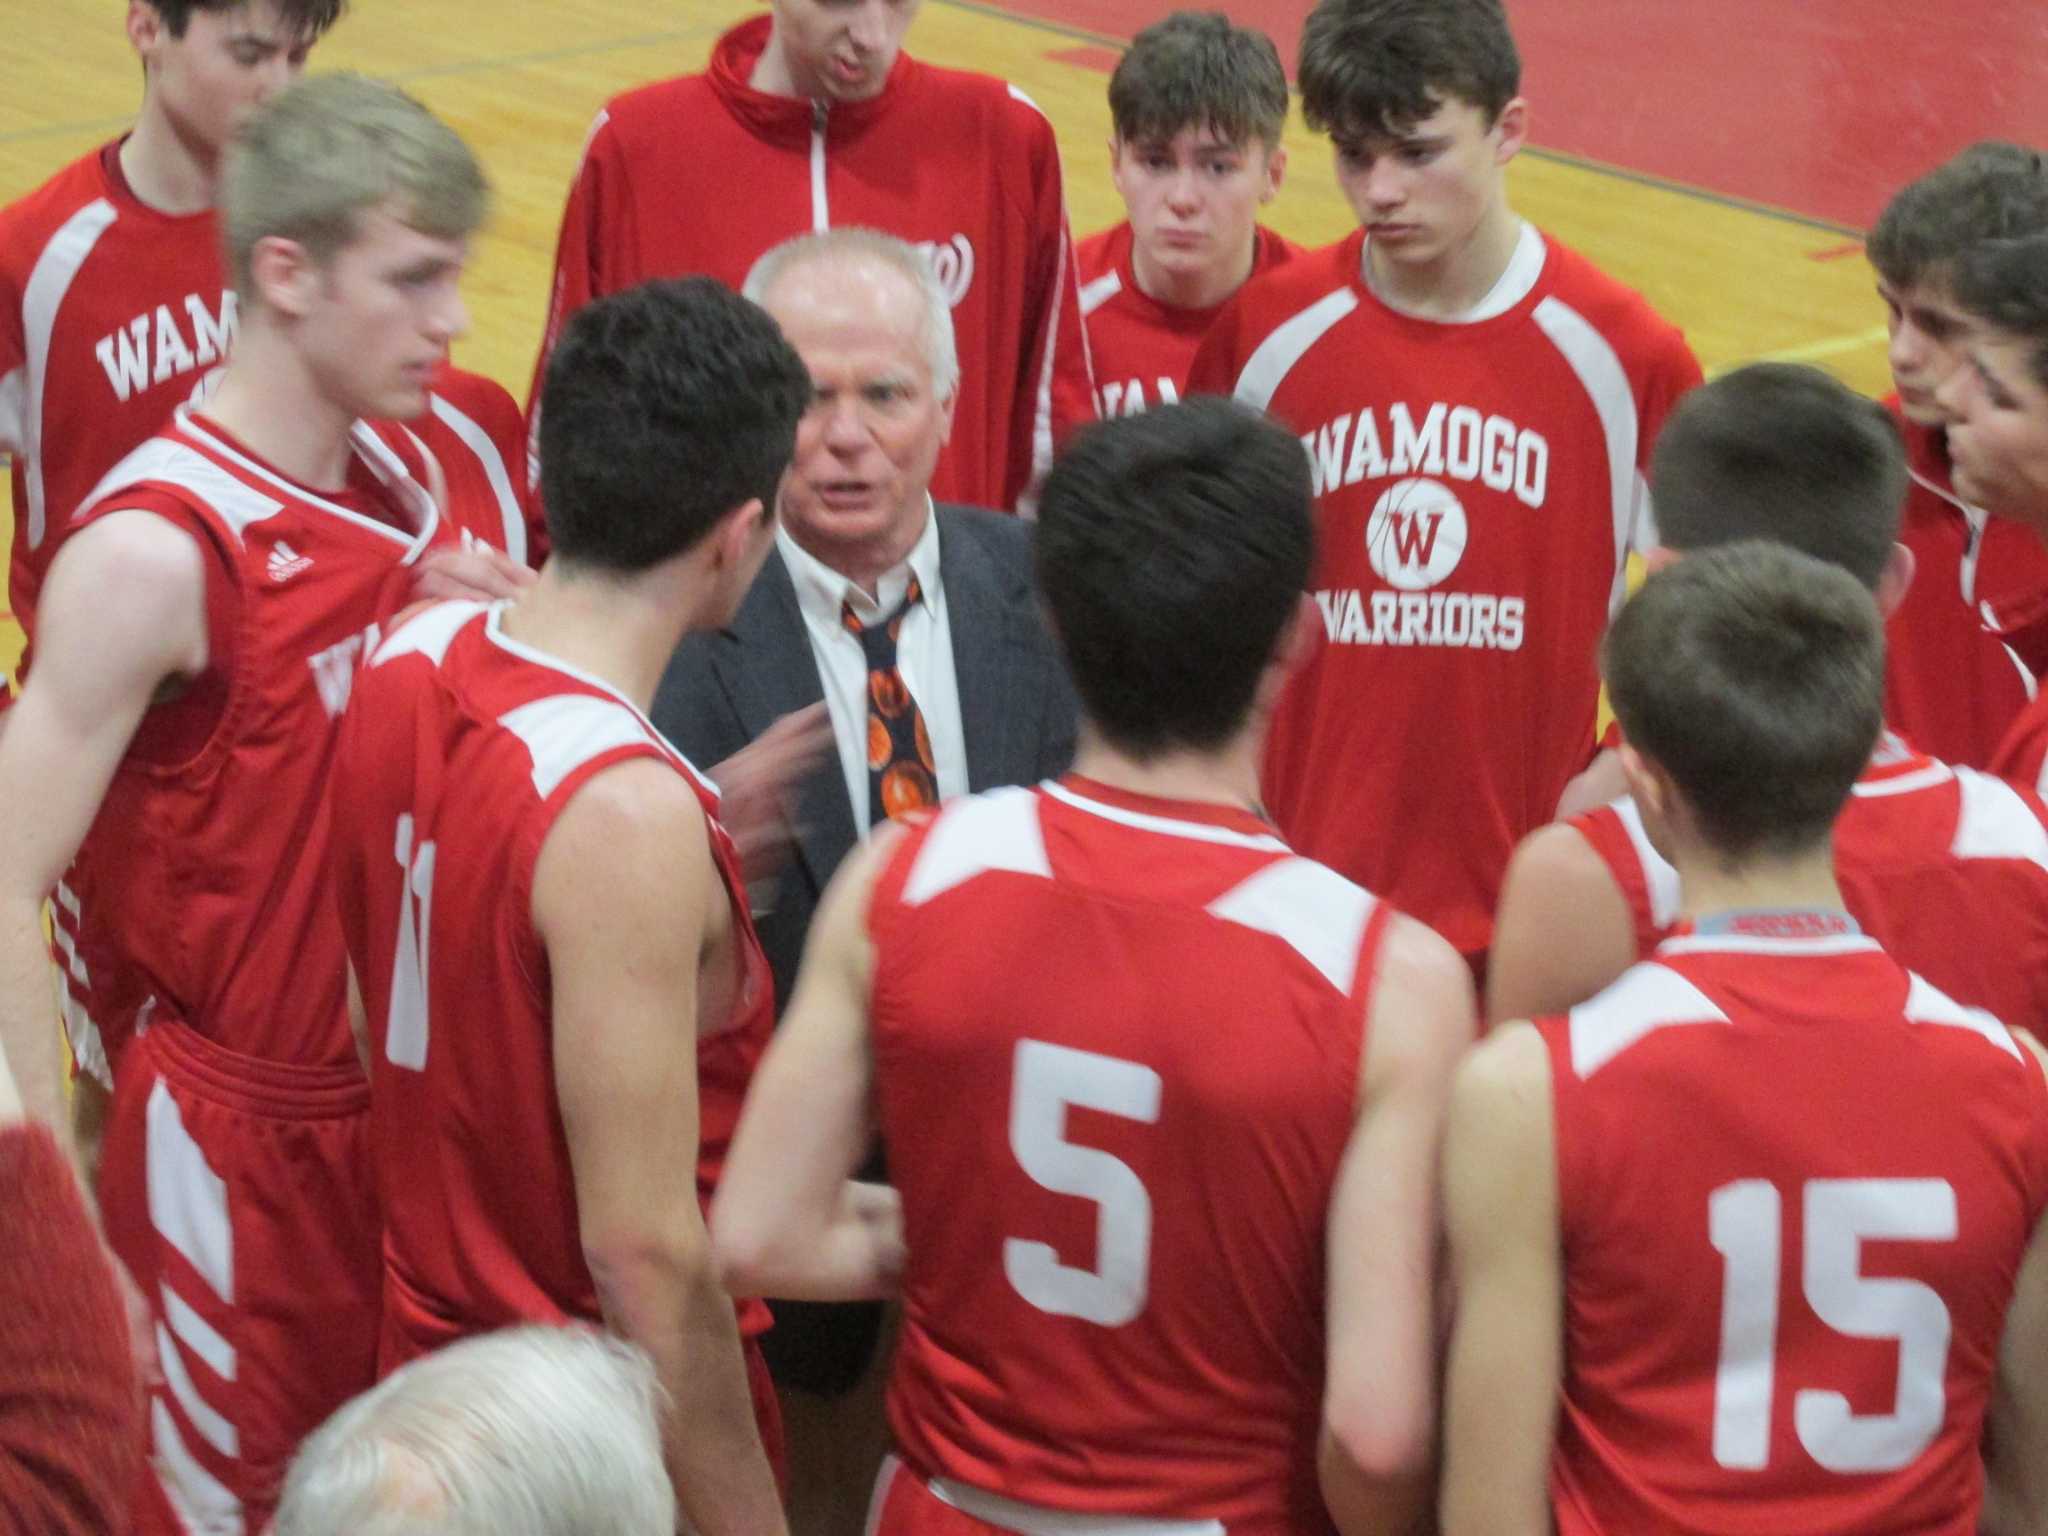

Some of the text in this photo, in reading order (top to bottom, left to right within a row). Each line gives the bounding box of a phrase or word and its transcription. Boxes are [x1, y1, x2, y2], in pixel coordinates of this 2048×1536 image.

[1301, 401, 1549, 509] WAMOGO
[1389, 508, 1445, 569] W
[1314, 588, 1526, 652] WARRIORS
[1002, 1036, 1163, 1328] 5
[1707, 1177, 1958, 1474] 15
